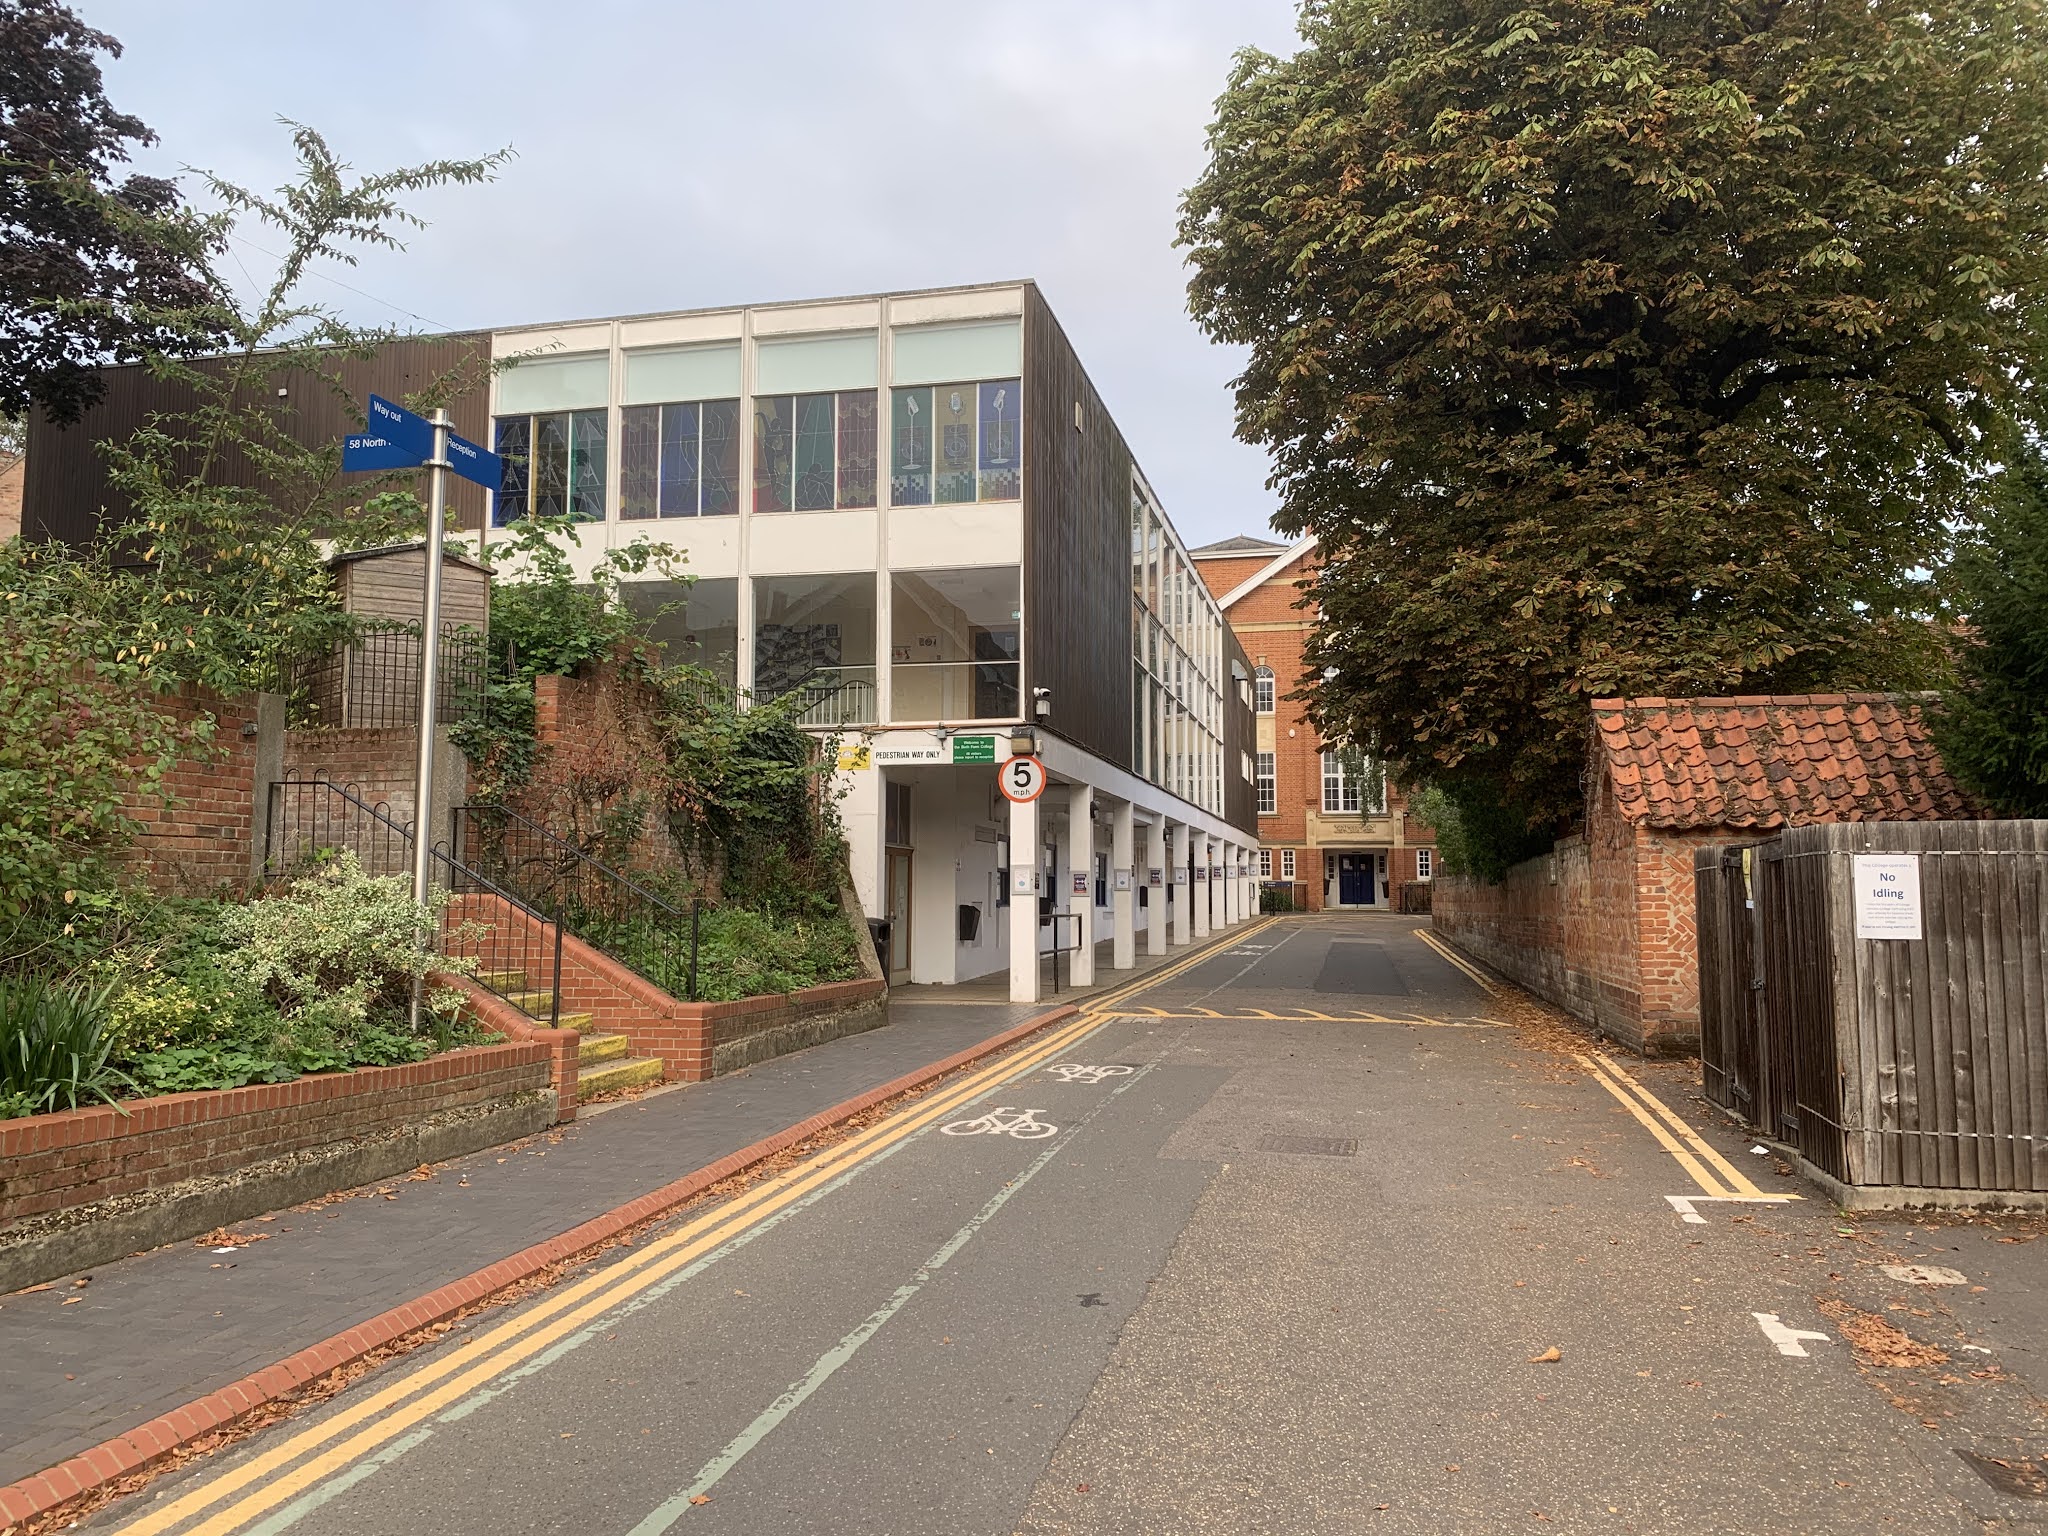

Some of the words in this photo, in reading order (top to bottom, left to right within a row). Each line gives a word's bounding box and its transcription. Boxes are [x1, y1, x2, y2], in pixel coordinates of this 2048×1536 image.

[373, 400, 390, 418] Way
[390, 411, 402, 422] out
[349, 439, 361, 449] 58
[362, 438, 387, 448] North
[447, 437, 477, 459] Reception
[875, 751, 910, 759] PEDESTRIAN
[925, 750, 941, 758] ONLY
[1013, 762, 1032, 788] 5
[1879, 872, 1896, 882] No
[1872, 888, 1904, 900] Idling
